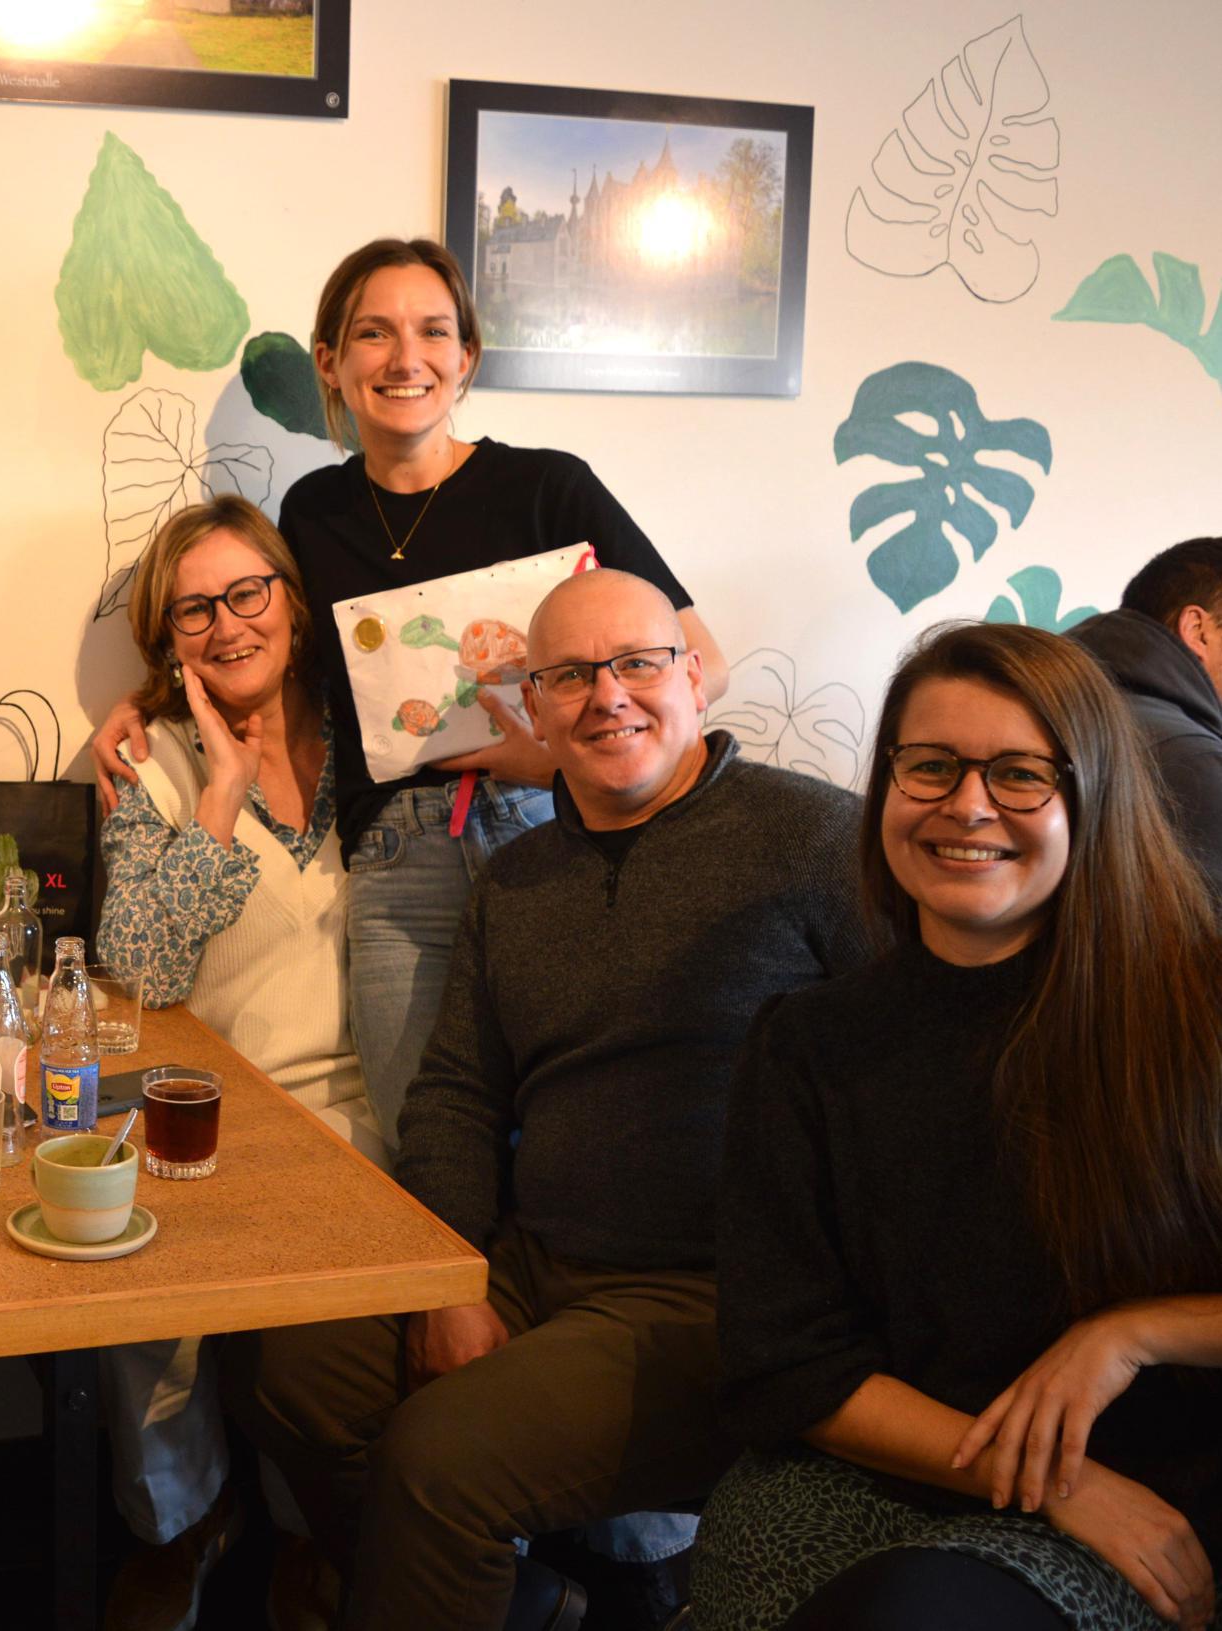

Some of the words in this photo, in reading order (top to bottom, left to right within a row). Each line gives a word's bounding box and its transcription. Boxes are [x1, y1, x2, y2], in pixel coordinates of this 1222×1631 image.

[45, 873, 67, 889] XL
[41, 906, 66, 915] shine
[52, 1083, 71, 1091] Lipton
